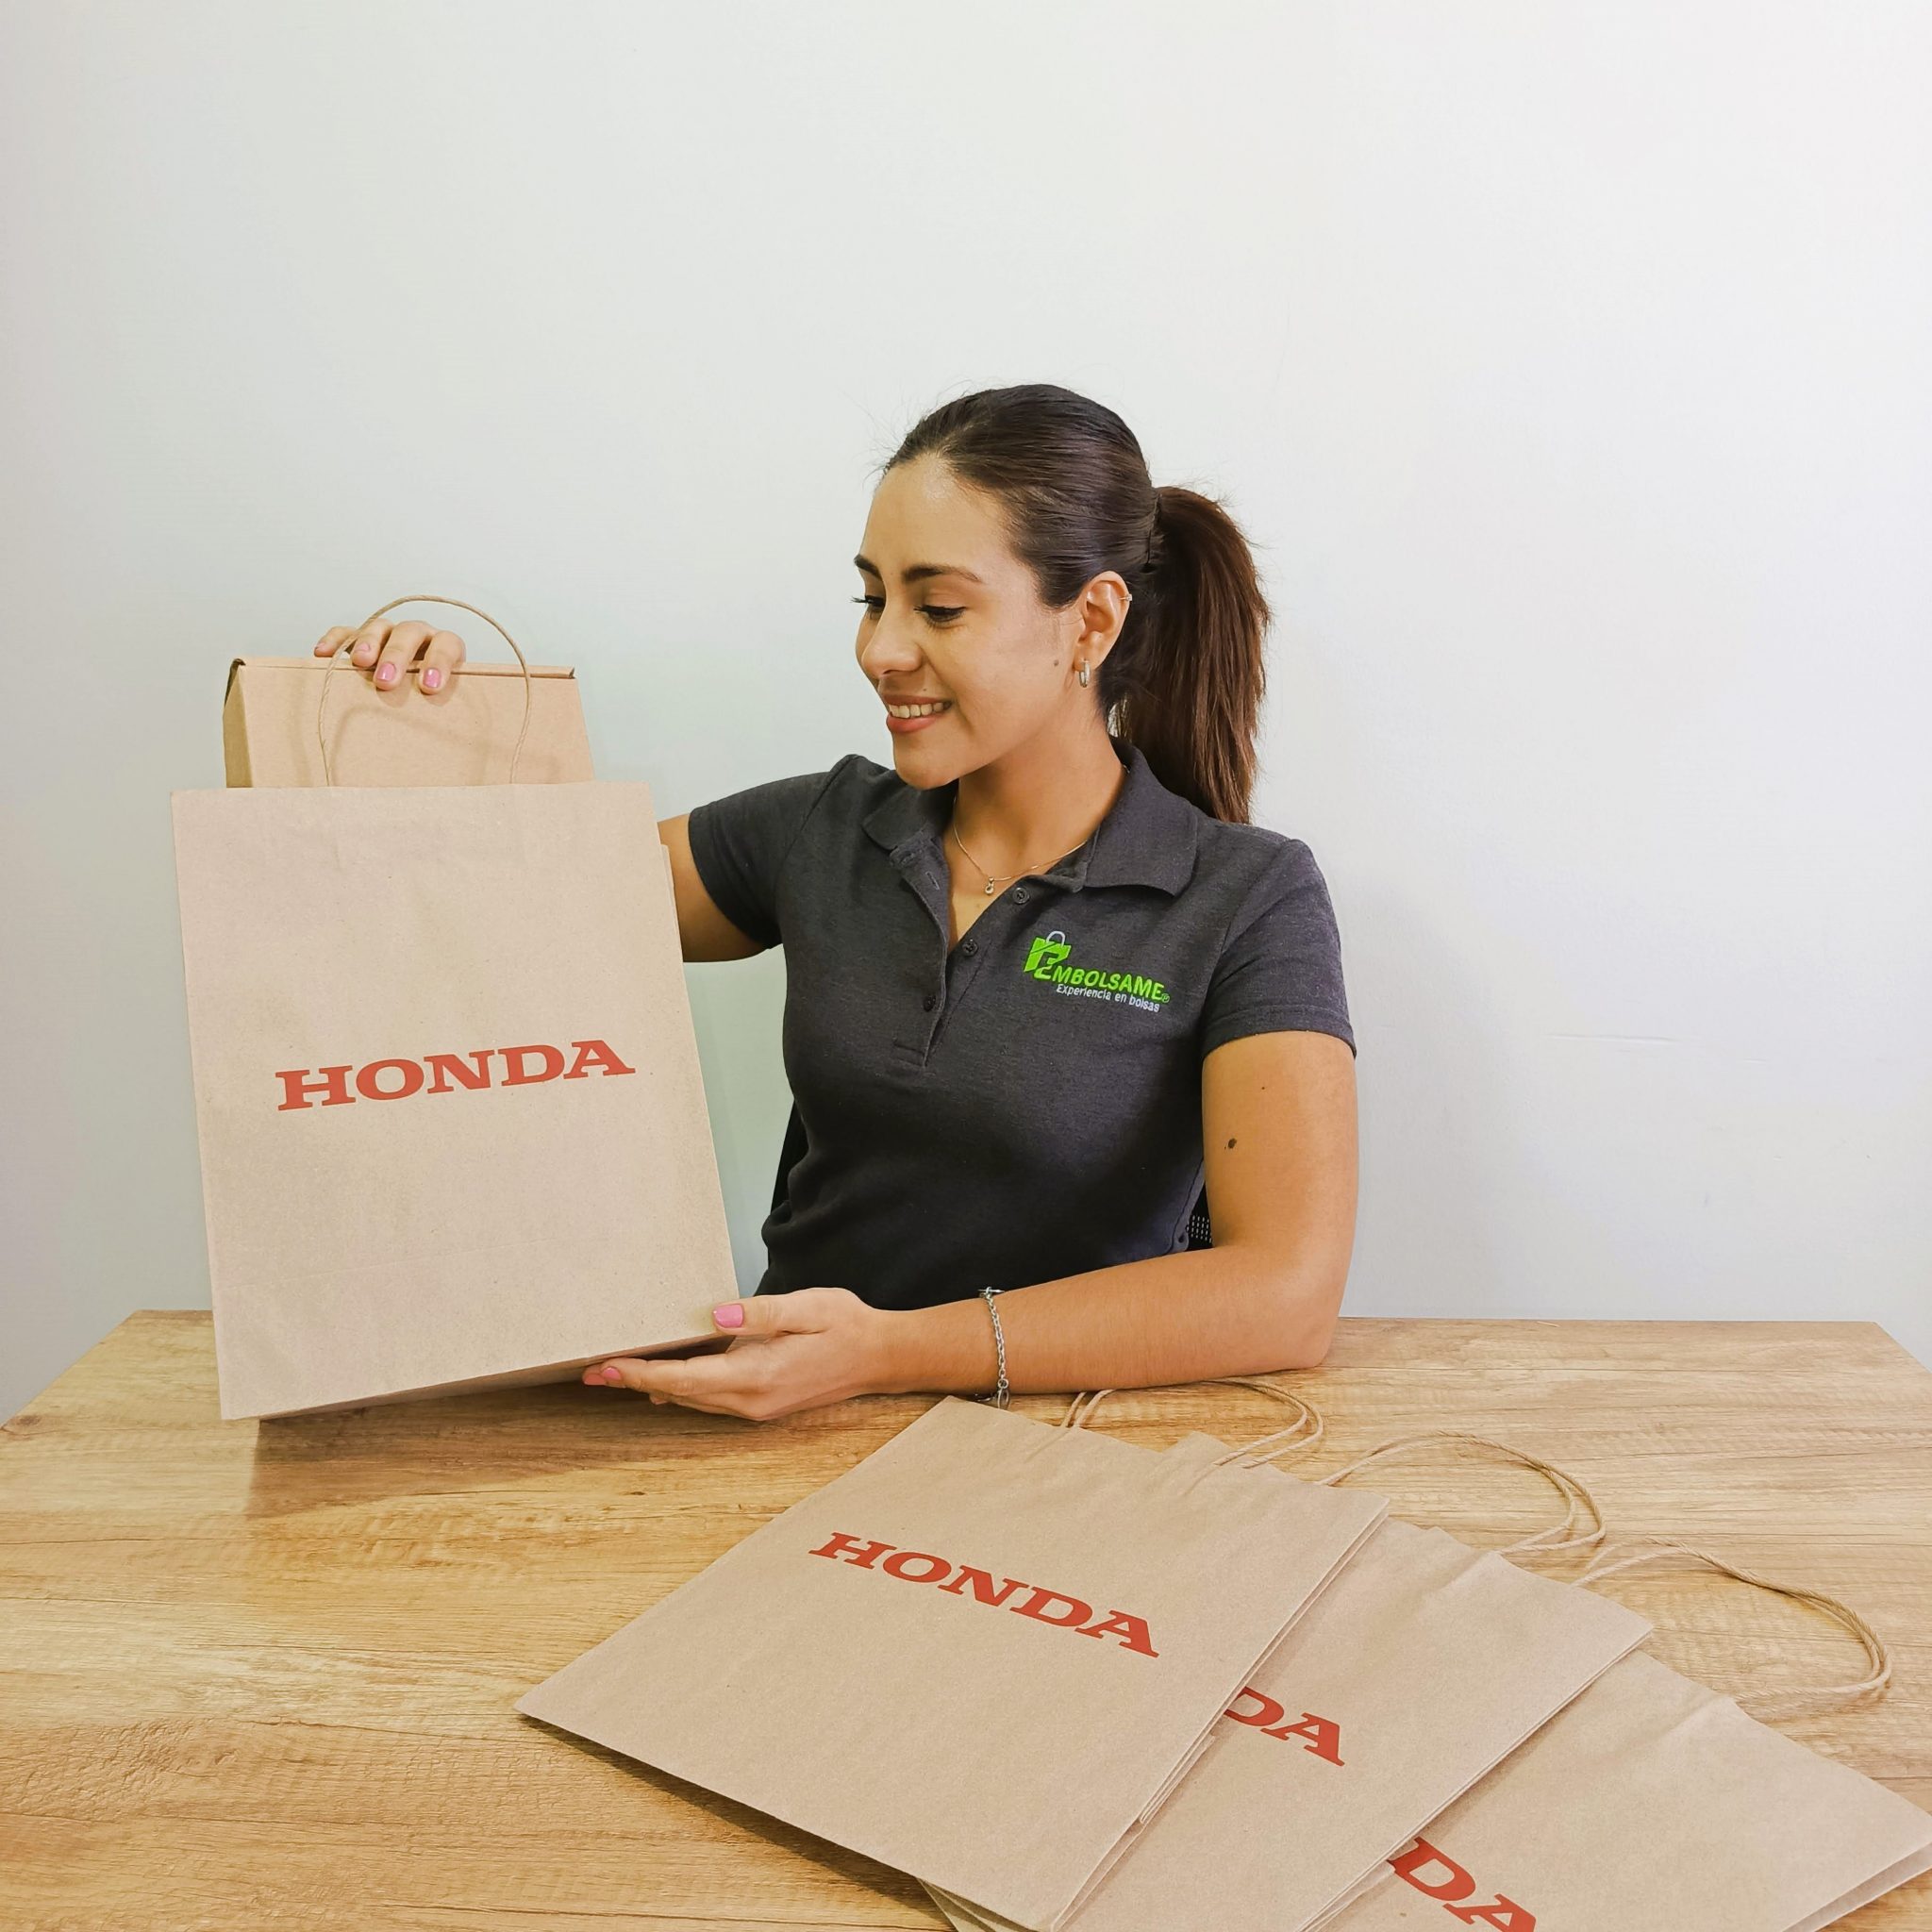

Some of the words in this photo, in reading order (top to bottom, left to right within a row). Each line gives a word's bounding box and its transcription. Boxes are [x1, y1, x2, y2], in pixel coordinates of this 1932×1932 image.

[1057, 983, 1111, 1001] Experiencia
[1114, 992, 1127, 1003] en
[1128, 994, 1160, 1013] bolsas
[275, 1040, 635, 1110] HONDA
[808, 1532, 1159, 1657] HONDA
